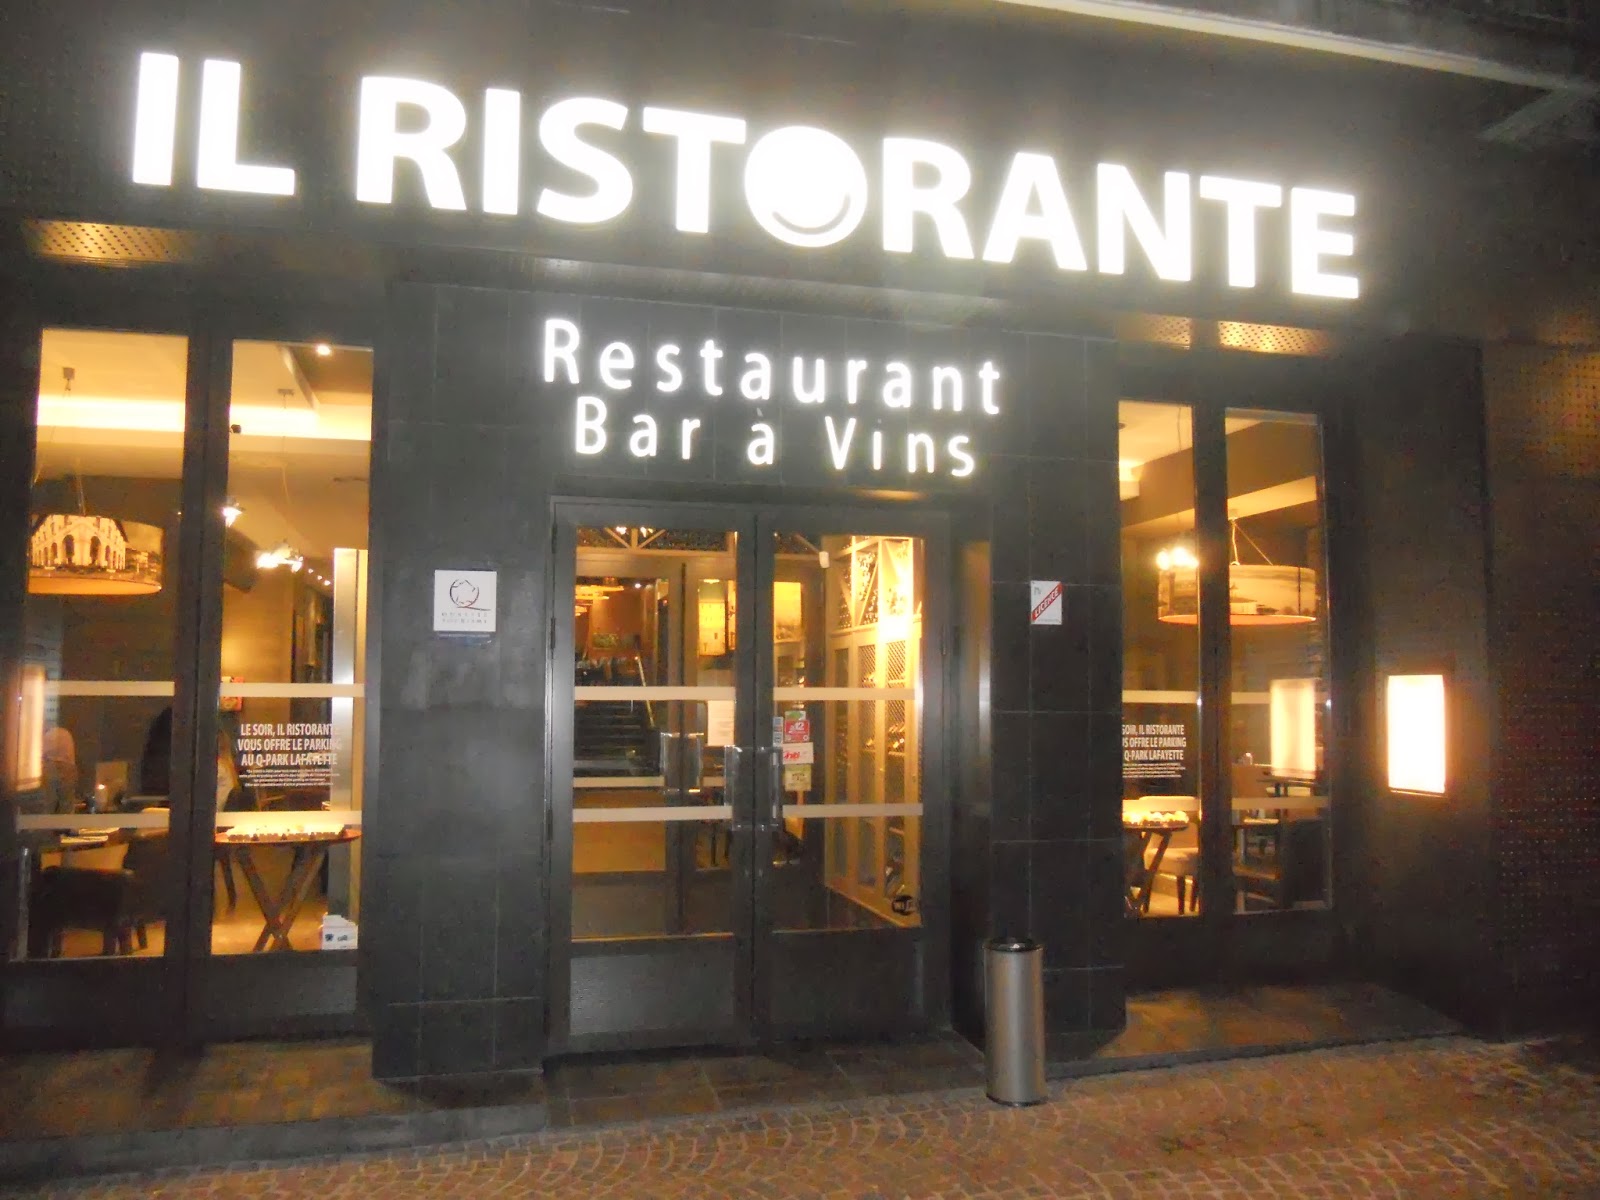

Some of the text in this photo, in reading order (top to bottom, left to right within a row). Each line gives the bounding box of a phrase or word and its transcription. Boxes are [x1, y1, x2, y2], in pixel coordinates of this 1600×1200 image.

[132, 52, 1360, 299] IL RISTORANTE
[543, 318, 1000, 415] Restaurant
[575, 396, 975, 478] Bar à Vins
[241, 723, 340, 737] LE SOIR, IL RISTORANT
[1138, 724, 1145, 735] IL
[1145, 724, 1184, 735] RISTORANTE
[238, 738, 341, 751] VOUS OFFRE LE PARKING
[1129, 737, 1150, 748] OFFRE
[1150, 737, 1158, 748] LE
[1158, 737, 1187, 748] PARKING
[241, 753, 254, 766] AU
[256, 753, 288, 767] Q-PARK
[1123, 749, 1184, 761] Q-PARK LAFAYETTE
